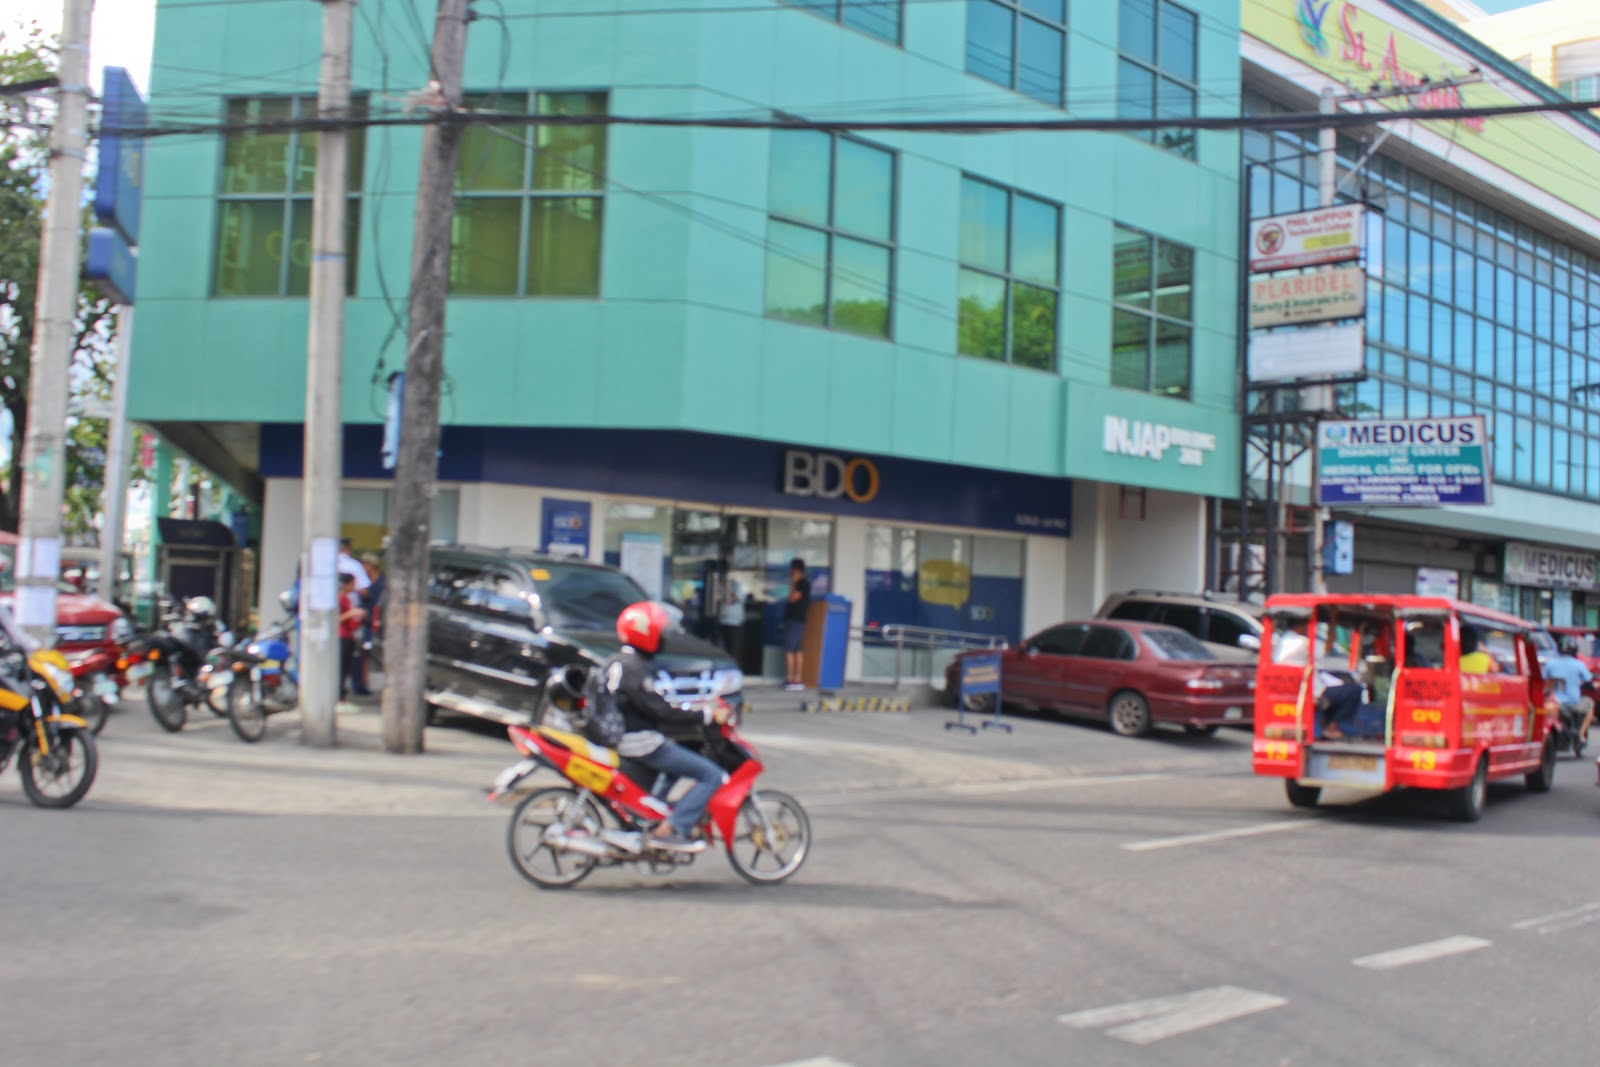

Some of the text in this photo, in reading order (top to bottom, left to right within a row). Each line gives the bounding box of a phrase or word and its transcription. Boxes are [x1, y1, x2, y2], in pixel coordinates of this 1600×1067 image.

[1255, 272, 1356, 301] PLARIDEL
[1104, 415, 1170, 460] INJAP
[1350, 423, 1475, 444] MEDICUS
[1411, 446, 1460, 457] CENTER
[784, 450, 880, 503] BDO
[1418, 464, 1443, 474] FOR
[1524, 548, 1594, 580] MEDICUS
